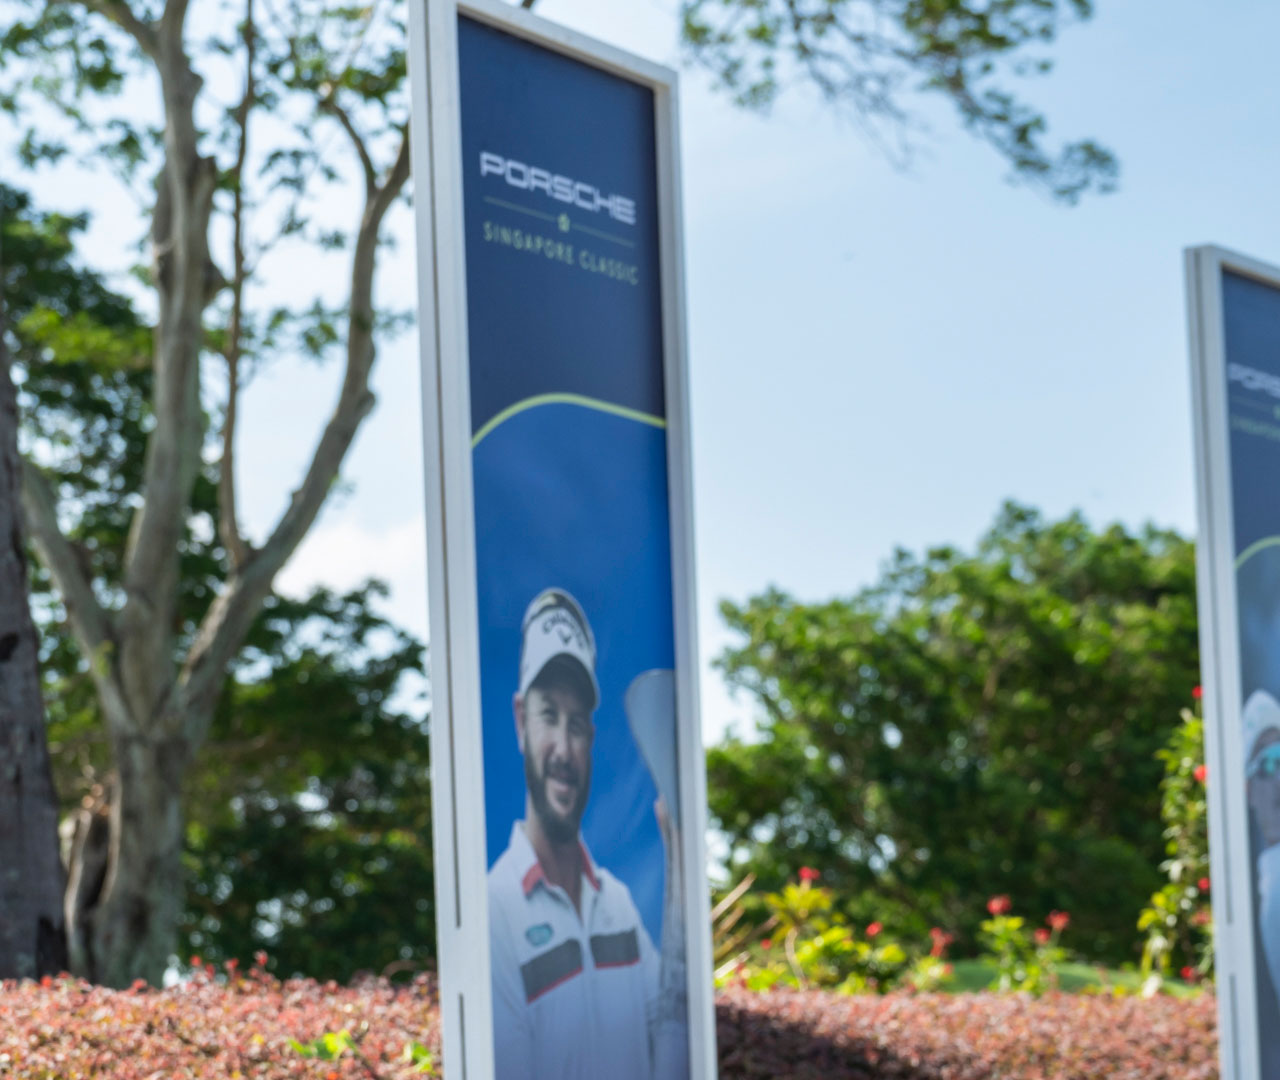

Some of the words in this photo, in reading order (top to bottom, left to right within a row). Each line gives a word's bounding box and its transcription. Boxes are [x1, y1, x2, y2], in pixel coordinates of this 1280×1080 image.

[480, 151, 637, 225] PORSCHE
[483, 220, 575, 265] SINGAPORE
[578, 250, 639, 285] CLASSIC
